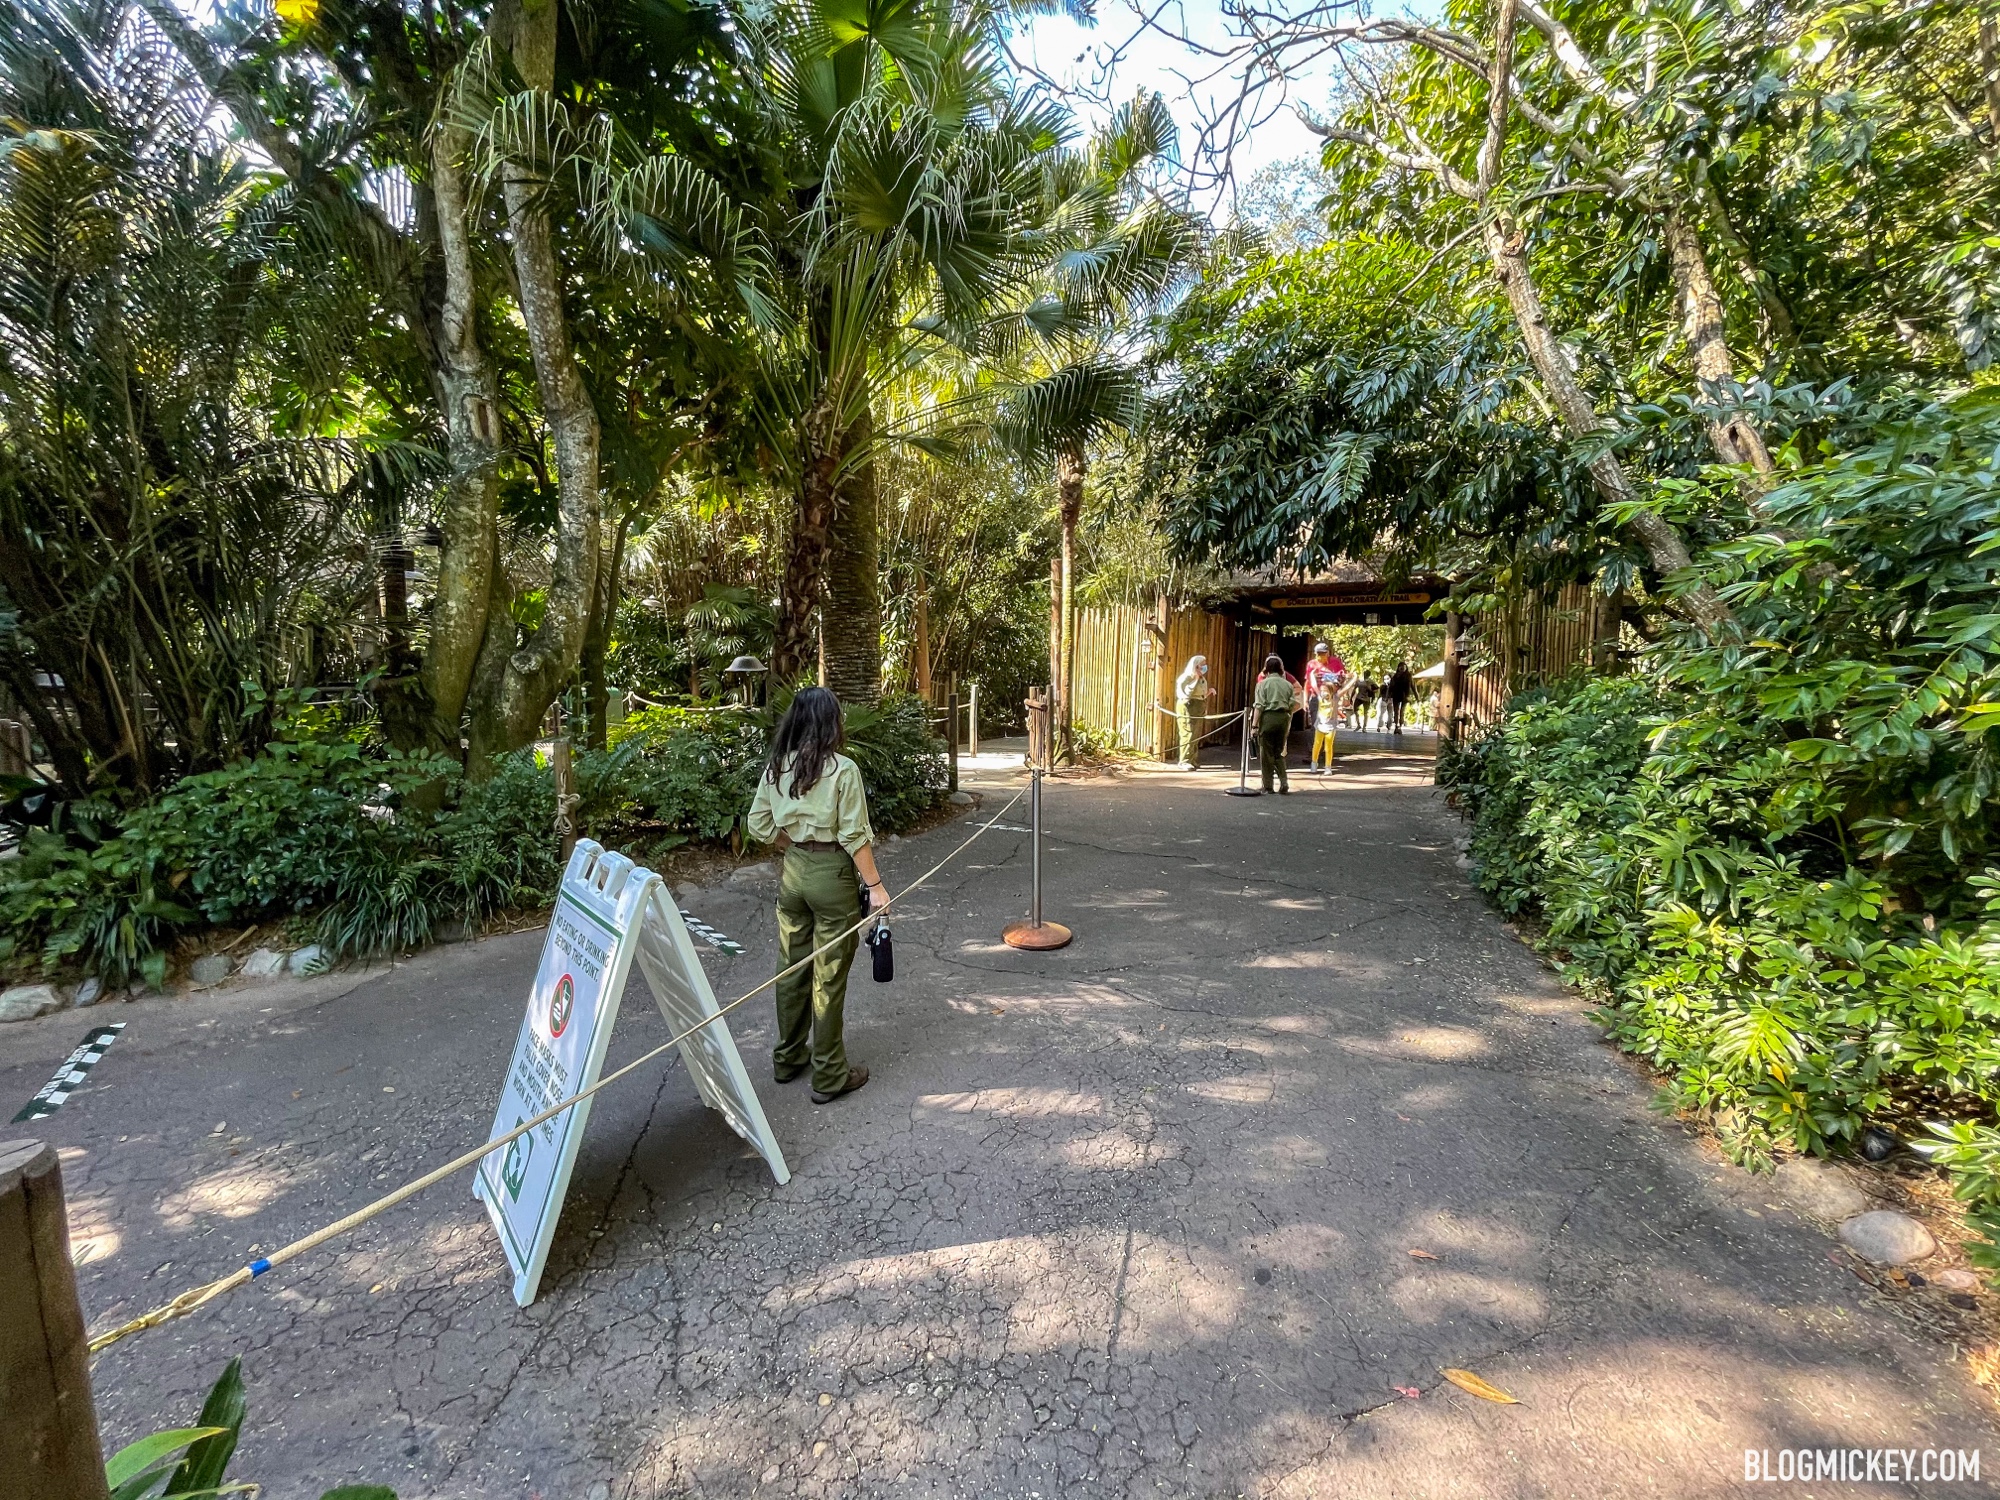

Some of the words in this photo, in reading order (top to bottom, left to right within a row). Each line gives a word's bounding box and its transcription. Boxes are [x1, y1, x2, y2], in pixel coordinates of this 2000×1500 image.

[1287, 598, 1315, 606] GORILLA
[554, 932, 572, 957] BEYOND
[570, 947, 583, 967] THIS
[581, 957, 600, 982] POINT.
[555, 914, 563, 929] NO
[561, 919, 578, 941] EATING
[576, 931, 586, 948] OR
[584, 938, 610, 969] DRINKING
[518, 1058, 528, 1079] AND
[526, 1070, 542, 1101] MOUTH
[524, 1043, 537, 1068] FULLY
[535, 1058, 551, 1088] COVER
[549, 1077, 563, 1105] NOSE
[528, 1027, 540, 1049] FACE
[538, 1040, 554, 1069] MASKS
[553, 1059, 567, 1086] MUST
[513, 1073, 526, 1100] WORN
[524, 1091, 531, 1109] AT
